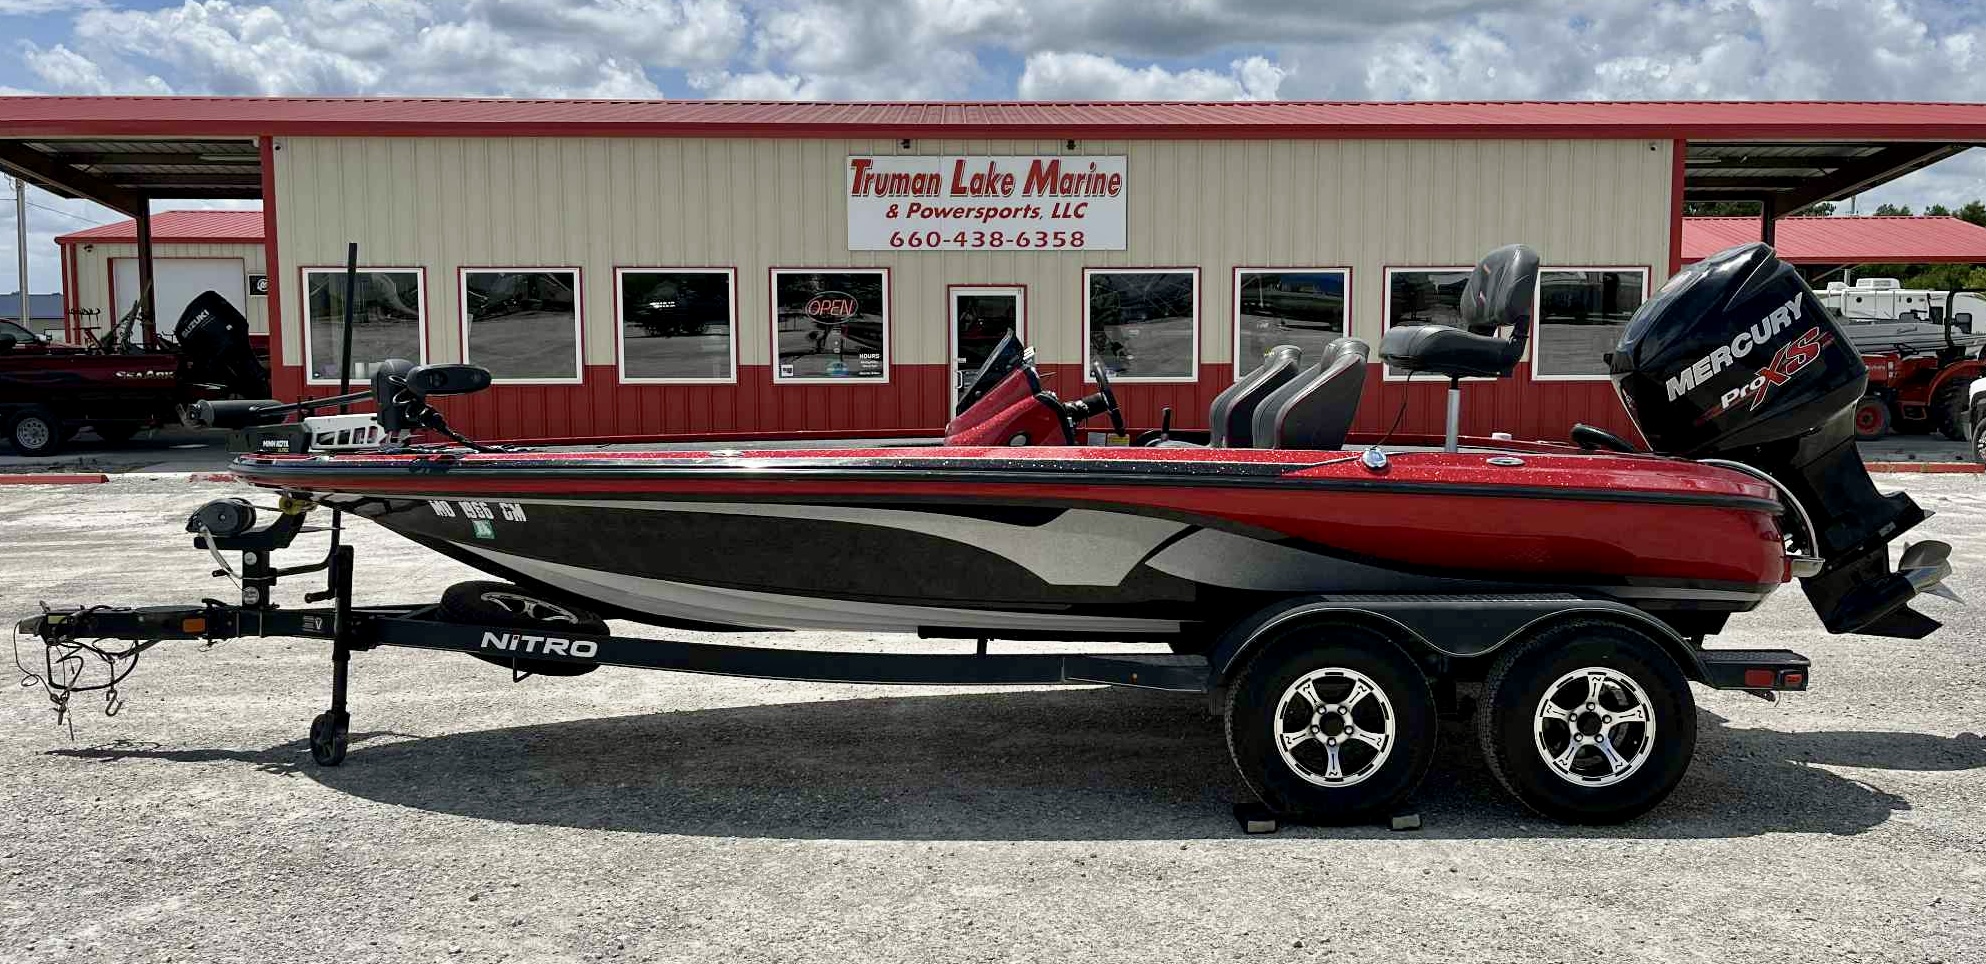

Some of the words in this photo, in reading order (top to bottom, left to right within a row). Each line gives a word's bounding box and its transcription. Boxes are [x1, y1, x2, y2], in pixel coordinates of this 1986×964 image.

[850, 158, 942, 197] Truman
[949, 159, 1016, 197] Lake
[1022, 159, 1122, 197] Marine
[885, 203, 899, 219] &
[906, 202, 1043, 223] Powersports,
[1051, 202, 1088, 219] LLC
[889, 231, 1085, 248] 660-438-6358
[808, 299, 854, 316] OPEN
[181, 309, 210, 339] SUZUKI
[1665, 292, 1803, 402] MERCURY
[428, 500, 456, 517] MO
[480, 631, 598, 658] NiTRO
